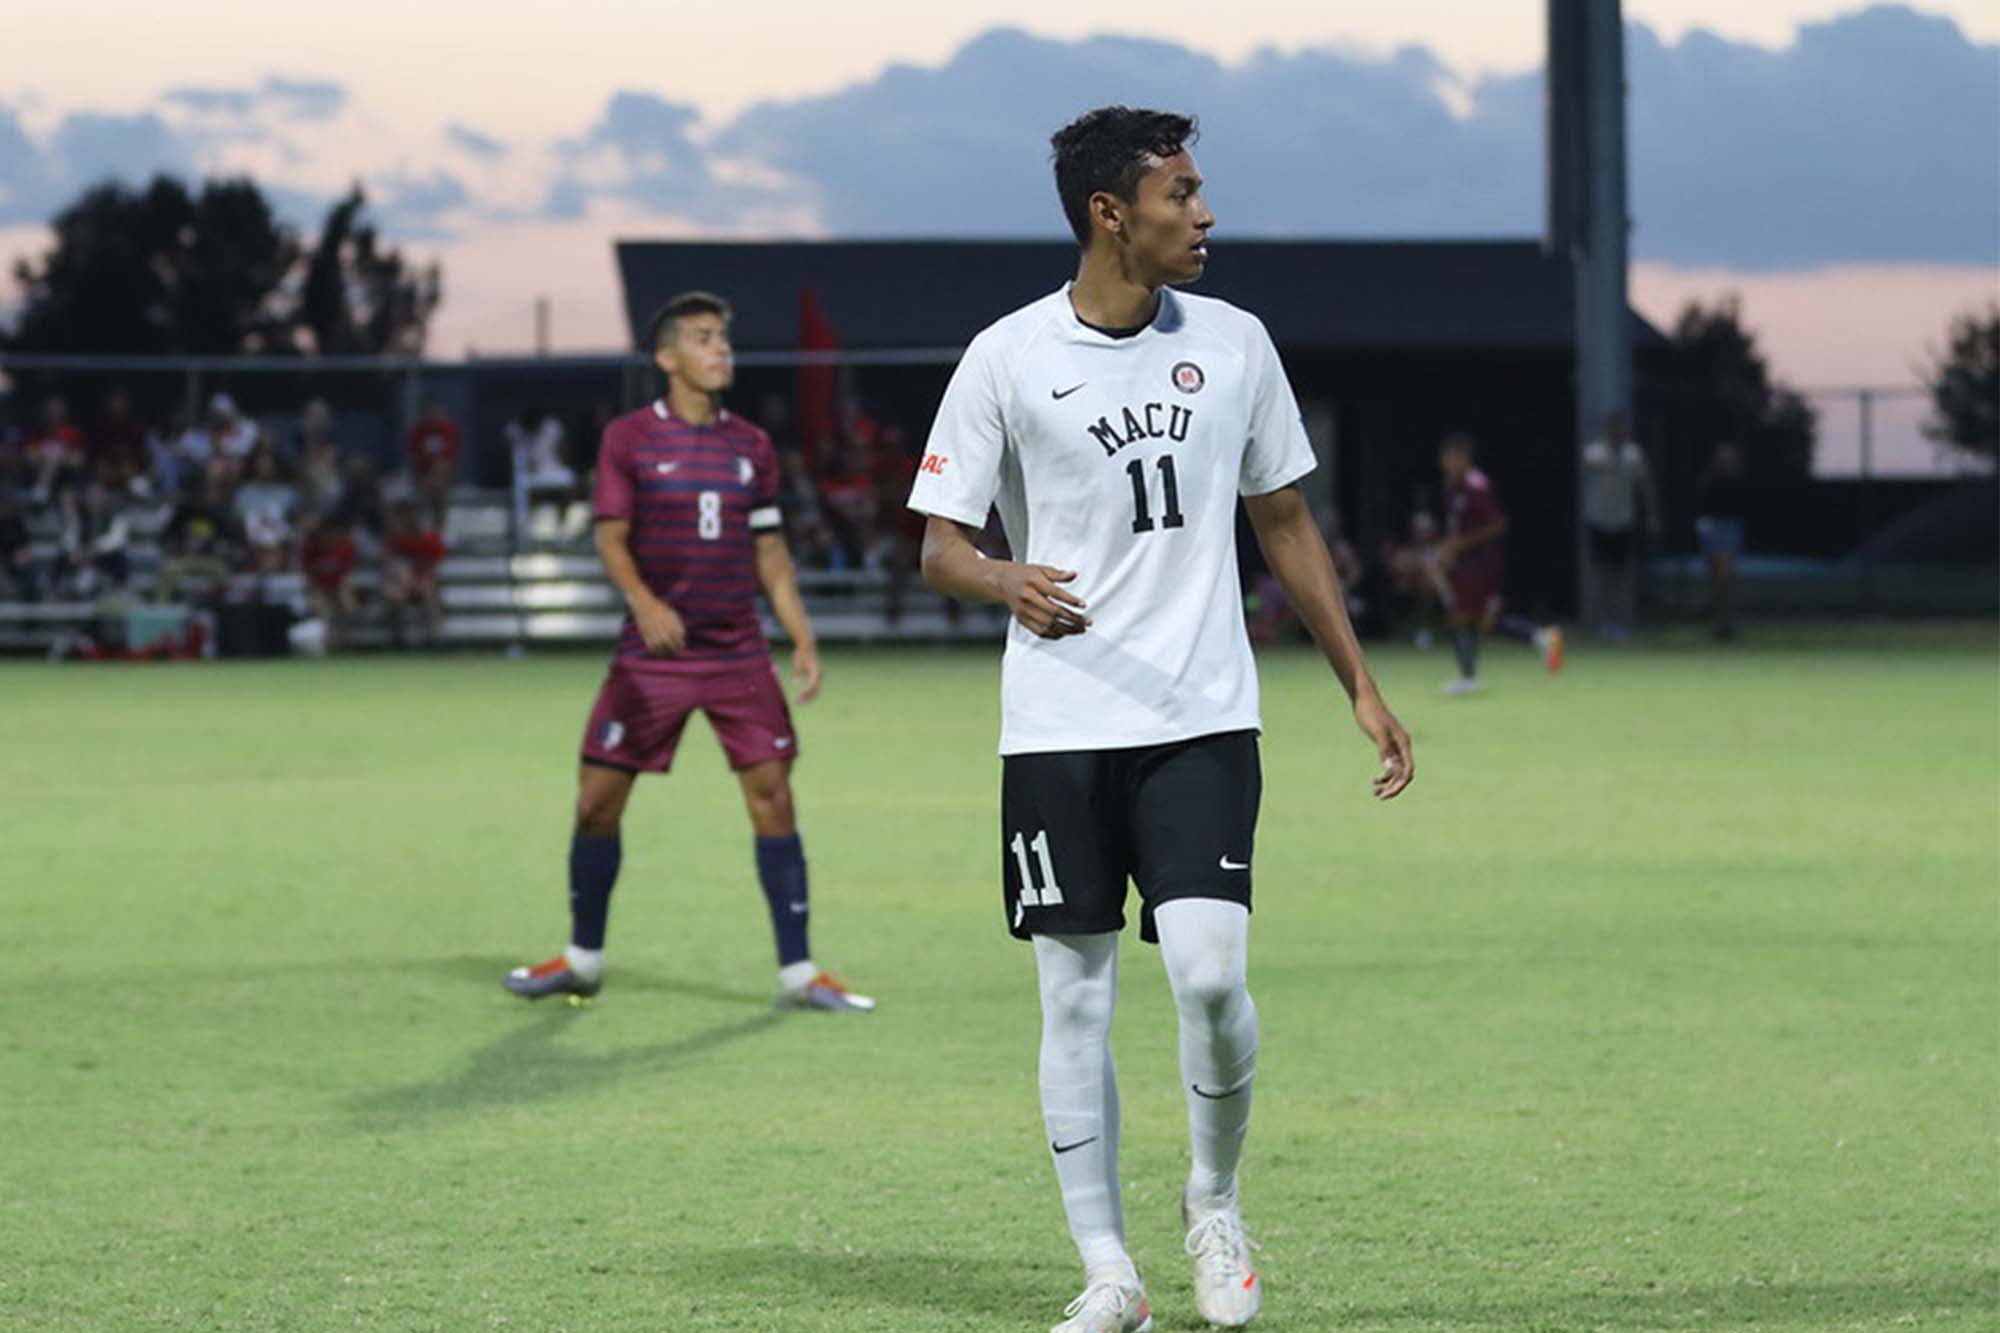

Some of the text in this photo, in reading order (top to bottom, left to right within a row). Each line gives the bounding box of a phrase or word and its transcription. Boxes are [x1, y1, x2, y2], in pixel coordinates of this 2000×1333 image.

[1087, 402, 1193, 457] MACU
[920, 453, 949, 475] AC
[698, 491, 721, 539] 8
[1127, 454, 1184, 533] 11
[1011, 830, 1064, 906] 11
